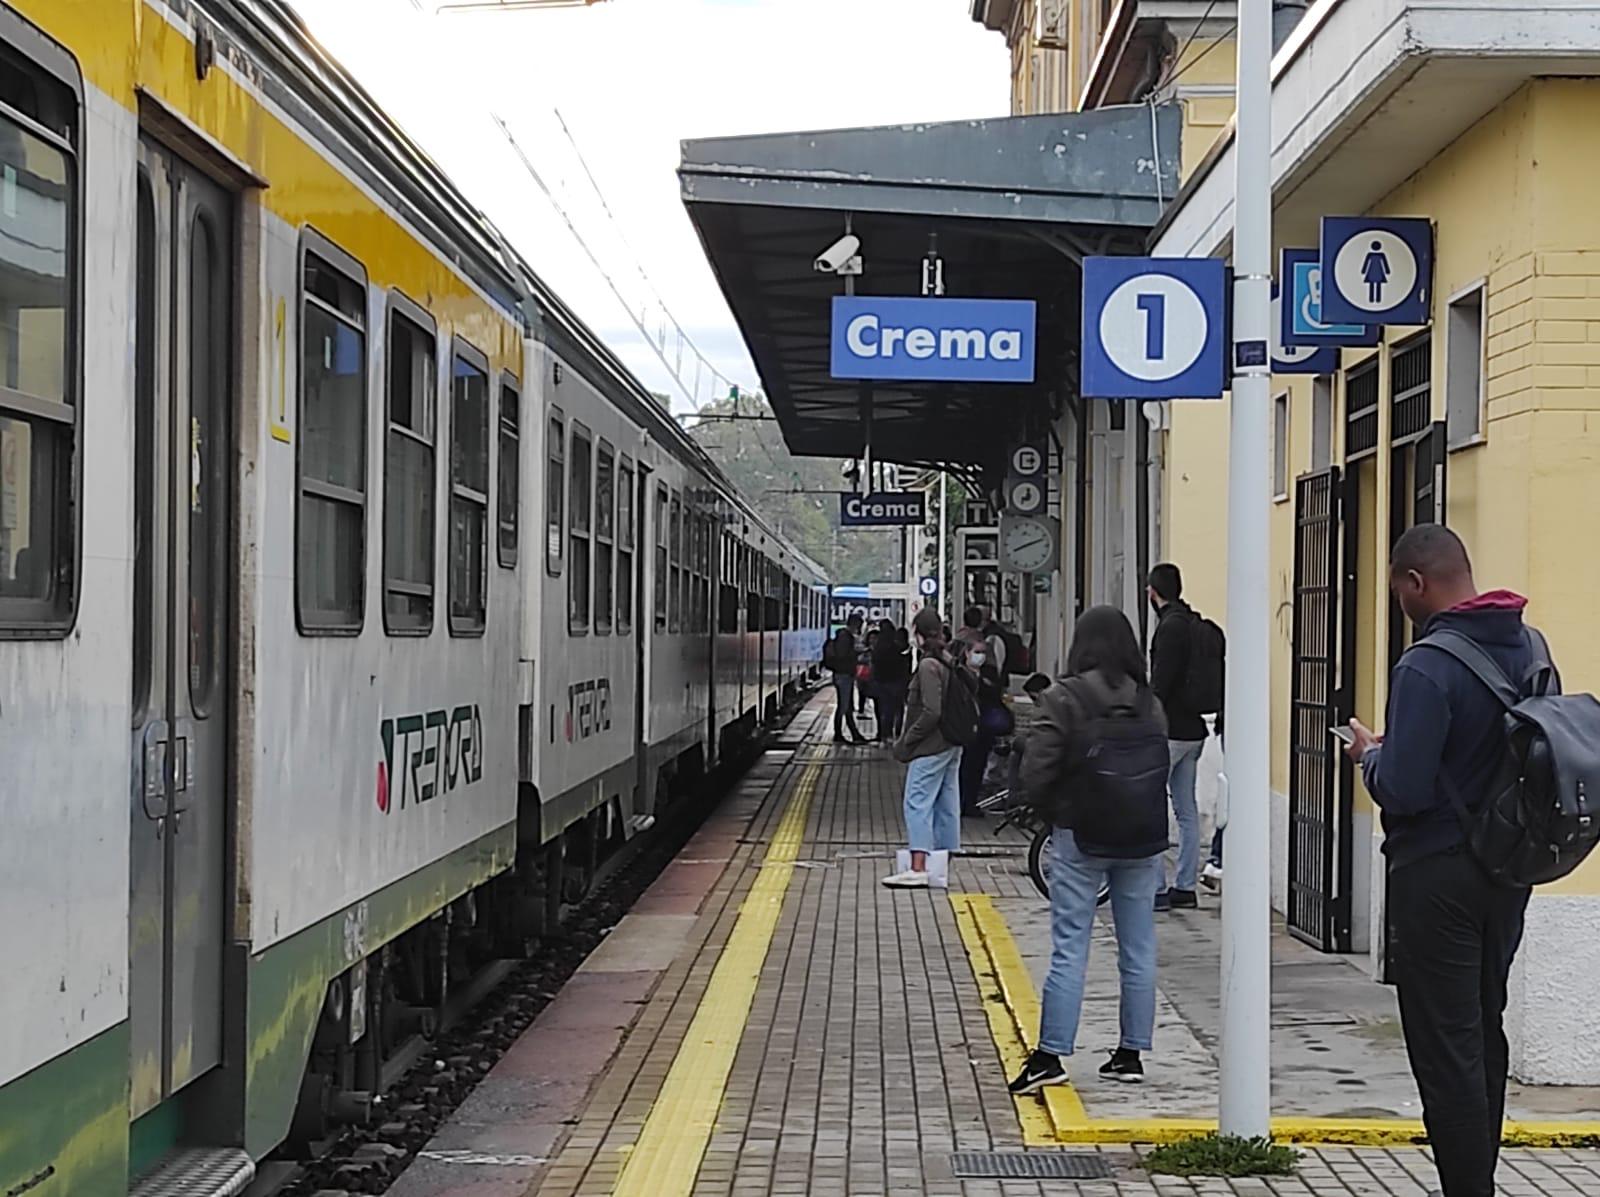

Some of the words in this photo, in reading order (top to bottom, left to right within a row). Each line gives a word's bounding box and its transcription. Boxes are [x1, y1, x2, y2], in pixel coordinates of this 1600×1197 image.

[847, 313, 1022, 361] Crema
[1136, 293, 1166, 361] 1
[846, 499, 920, 518] Crema
[396, 703, 482, 810] TRENORD
